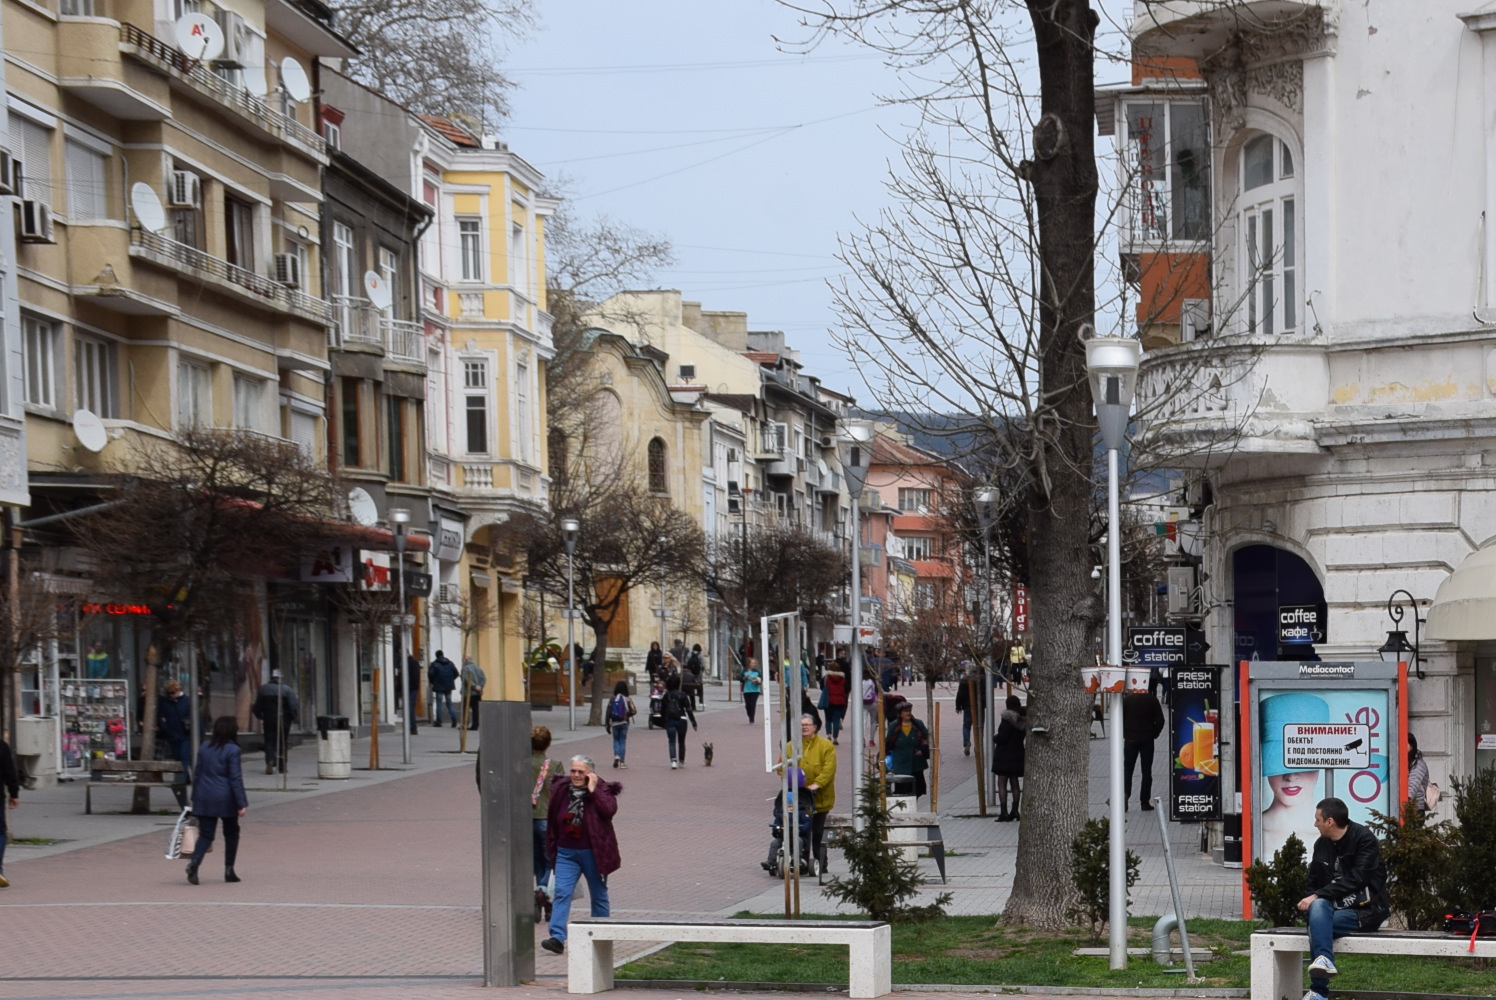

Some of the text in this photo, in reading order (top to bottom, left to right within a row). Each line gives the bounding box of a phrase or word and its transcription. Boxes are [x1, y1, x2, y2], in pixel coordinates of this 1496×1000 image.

[1280, 609, 1317, 623] coffee
[1281, 626, 1308, 639] кафе
[1133, 631, 1184, 646] coffee
[1144, 651, 1184, 662] station
[1299, 664, 1355, 674] Mediacontact
[1177, 672, 1212, 681] FRESH
[1177, 681, 1212, 689] station
[1297, 726, 1357, 735] ВНИМАНИЕ!
[1287, 747, 1343, 756] Е ПОД ПОСТОЯННО
[1287, 757, 1351, 766] ВИДЕОНАБЛЮДЕНИЕ
[1178, 795, 1213, 804] FRESH
[1178, 803, 1213, 812] station
